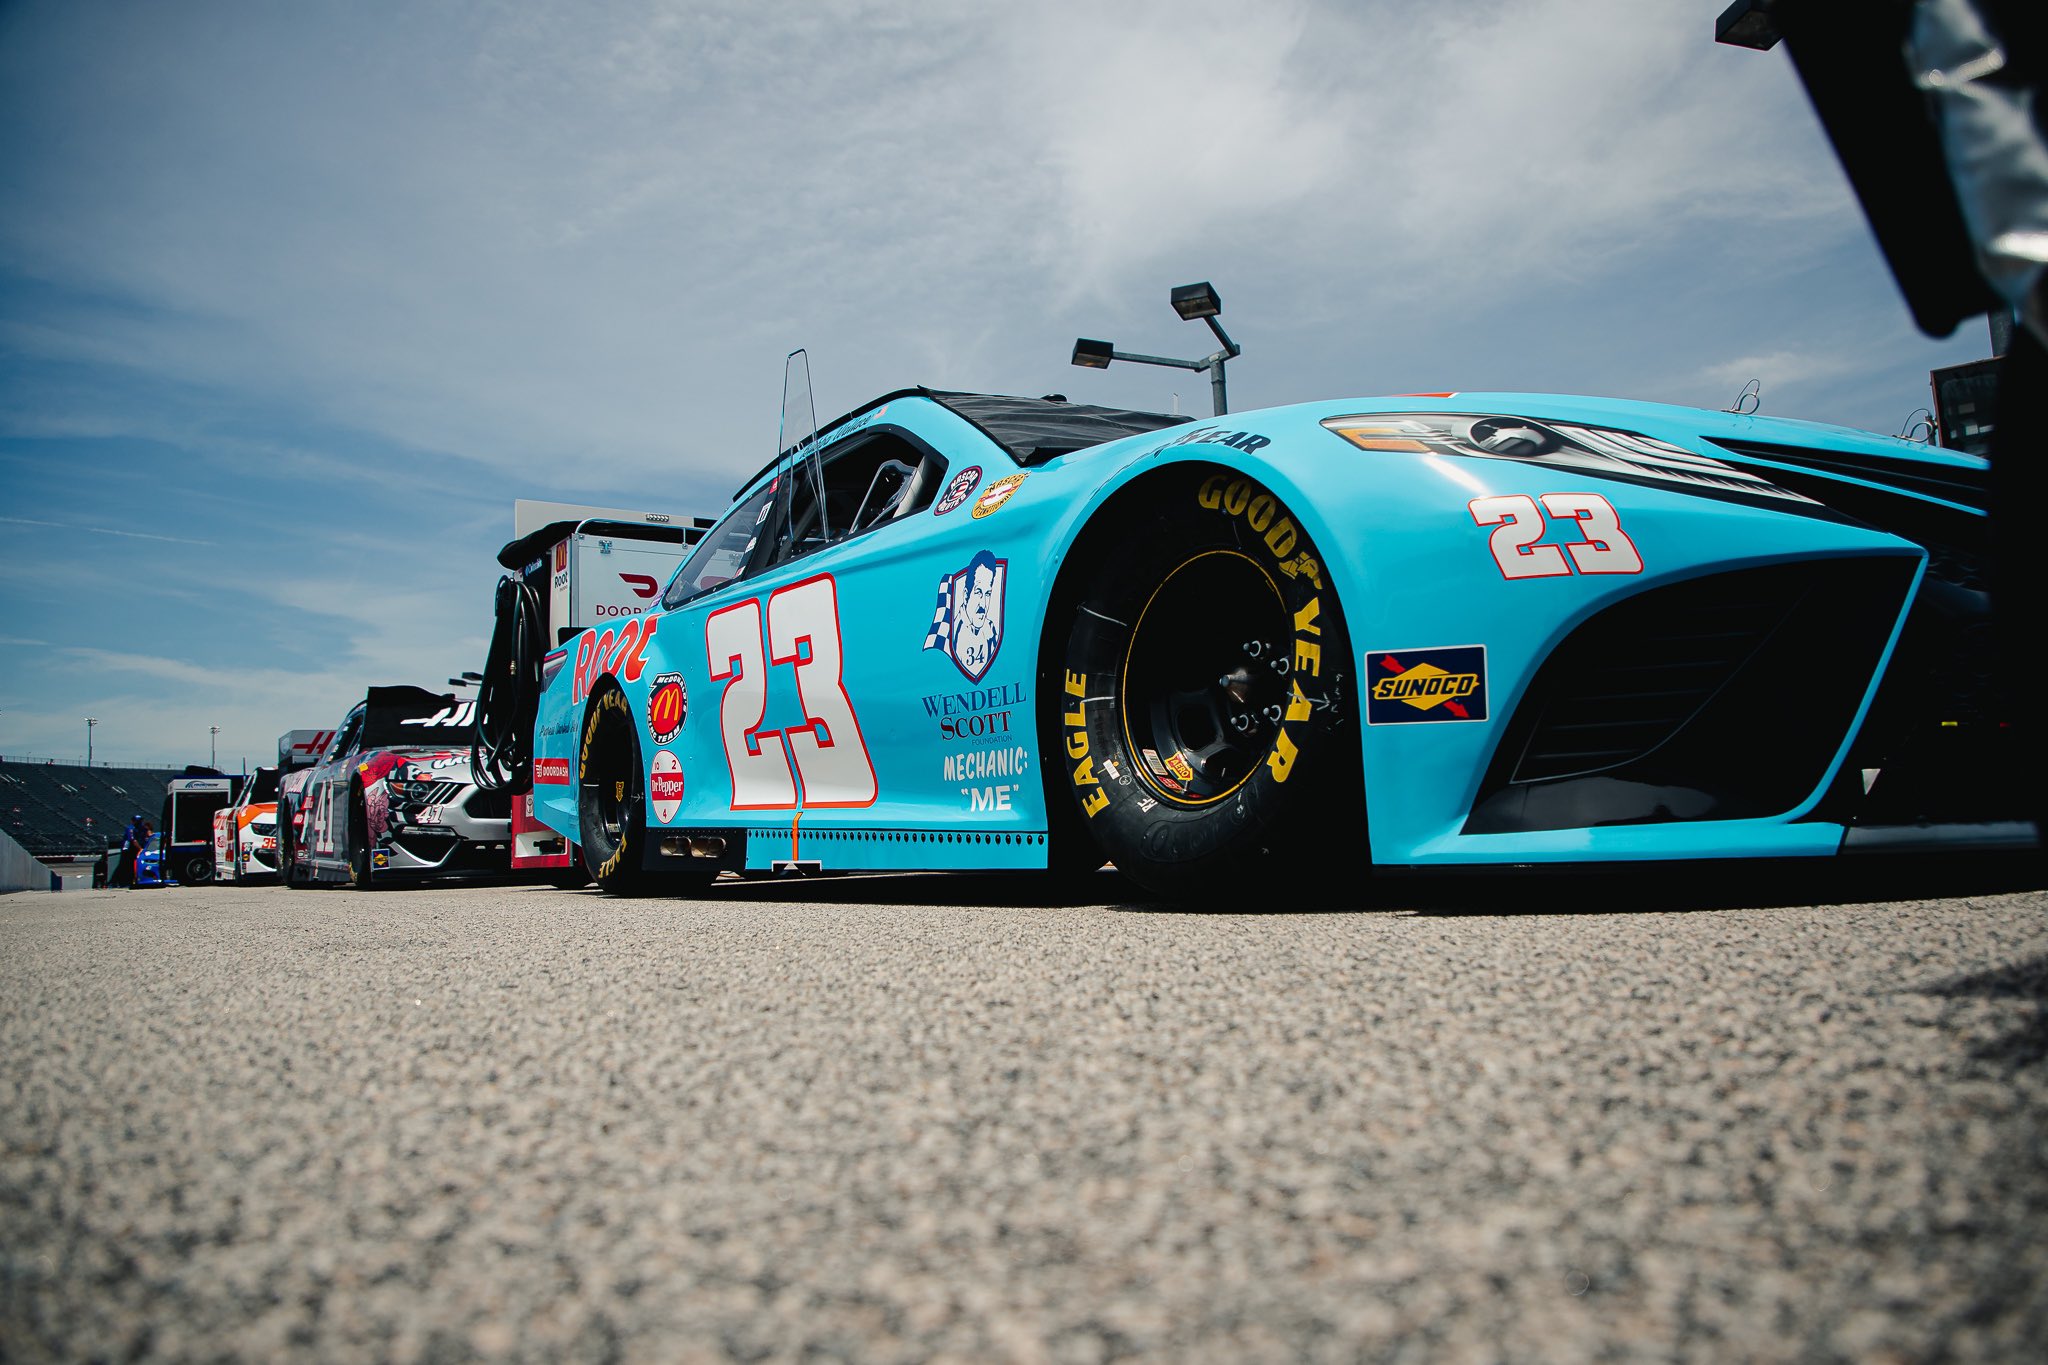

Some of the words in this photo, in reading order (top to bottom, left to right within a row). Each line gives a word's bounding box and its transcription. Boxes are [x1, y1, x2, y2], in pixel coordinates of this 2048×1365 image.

[1468, 493, 1644, 580] 23
[1198, 475, 1323, 783] GOODYEAR
[966, 644, 985, 667] 34
[705, 572, 879, 811] 23
[1376, 673, 1477, 699] SUNOCO
[921, 682, 1027, 718] WENDELL
[657, 724, 680, 743] TEAM
[940, 710, 1012, 741] SCOTT
[971, 734, 1013, 746] FOUNDATION
[1065, 668, 1111, 818] EAGLE
[542, 765, 569, 777] DOORDASH
[671, 759, 677, 770] 2
[943, 746, 1028, 782] MECHANIC:
[1173, 758, 1189, 778] AERO
[314, 779, 334, 852] 41
[416, 805, 445, 824] 41
[662, 808, 668, 819] 4
